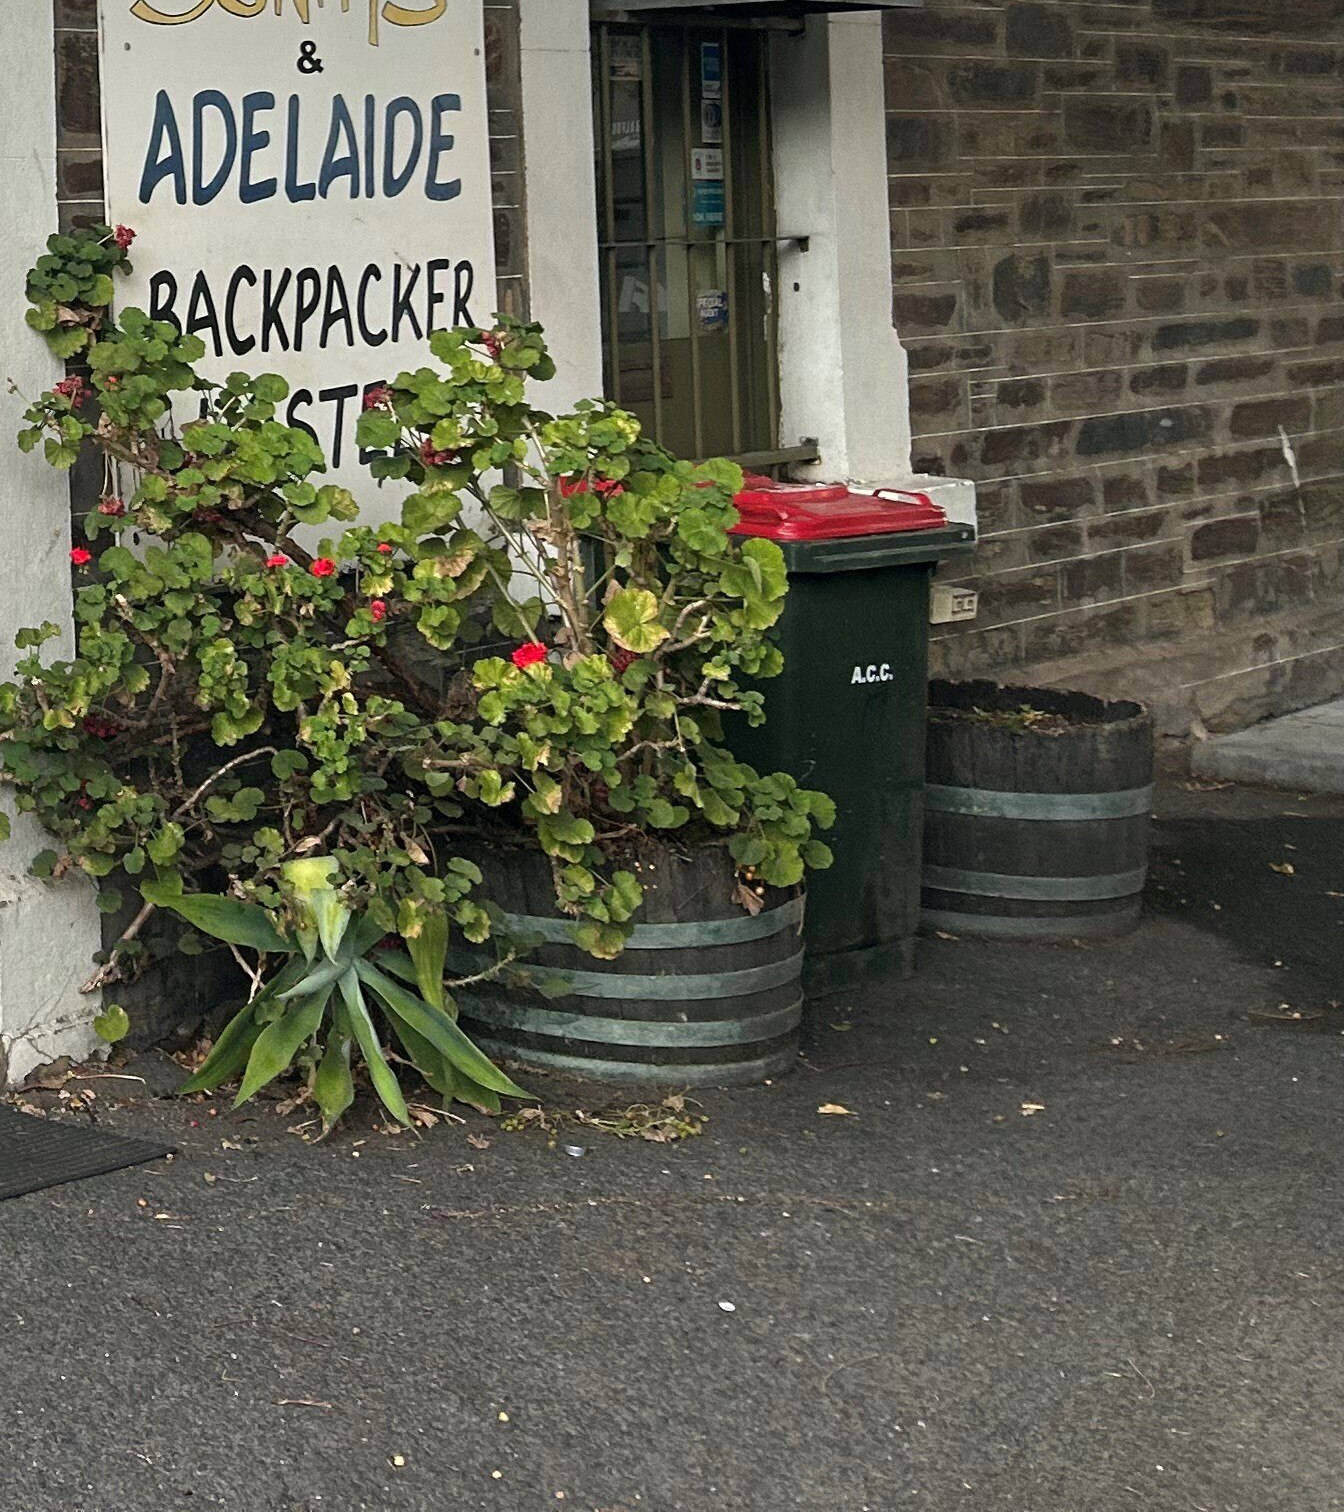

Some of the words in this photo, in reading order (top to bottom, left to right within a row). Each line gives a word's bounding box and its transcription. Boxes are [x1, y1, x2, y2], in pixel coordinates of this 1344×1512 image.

[296, 40, 324, 74] &
[139, 89, 461, 205] ADELAIDE
[149, 259, 474, 357] BACKPACKER
